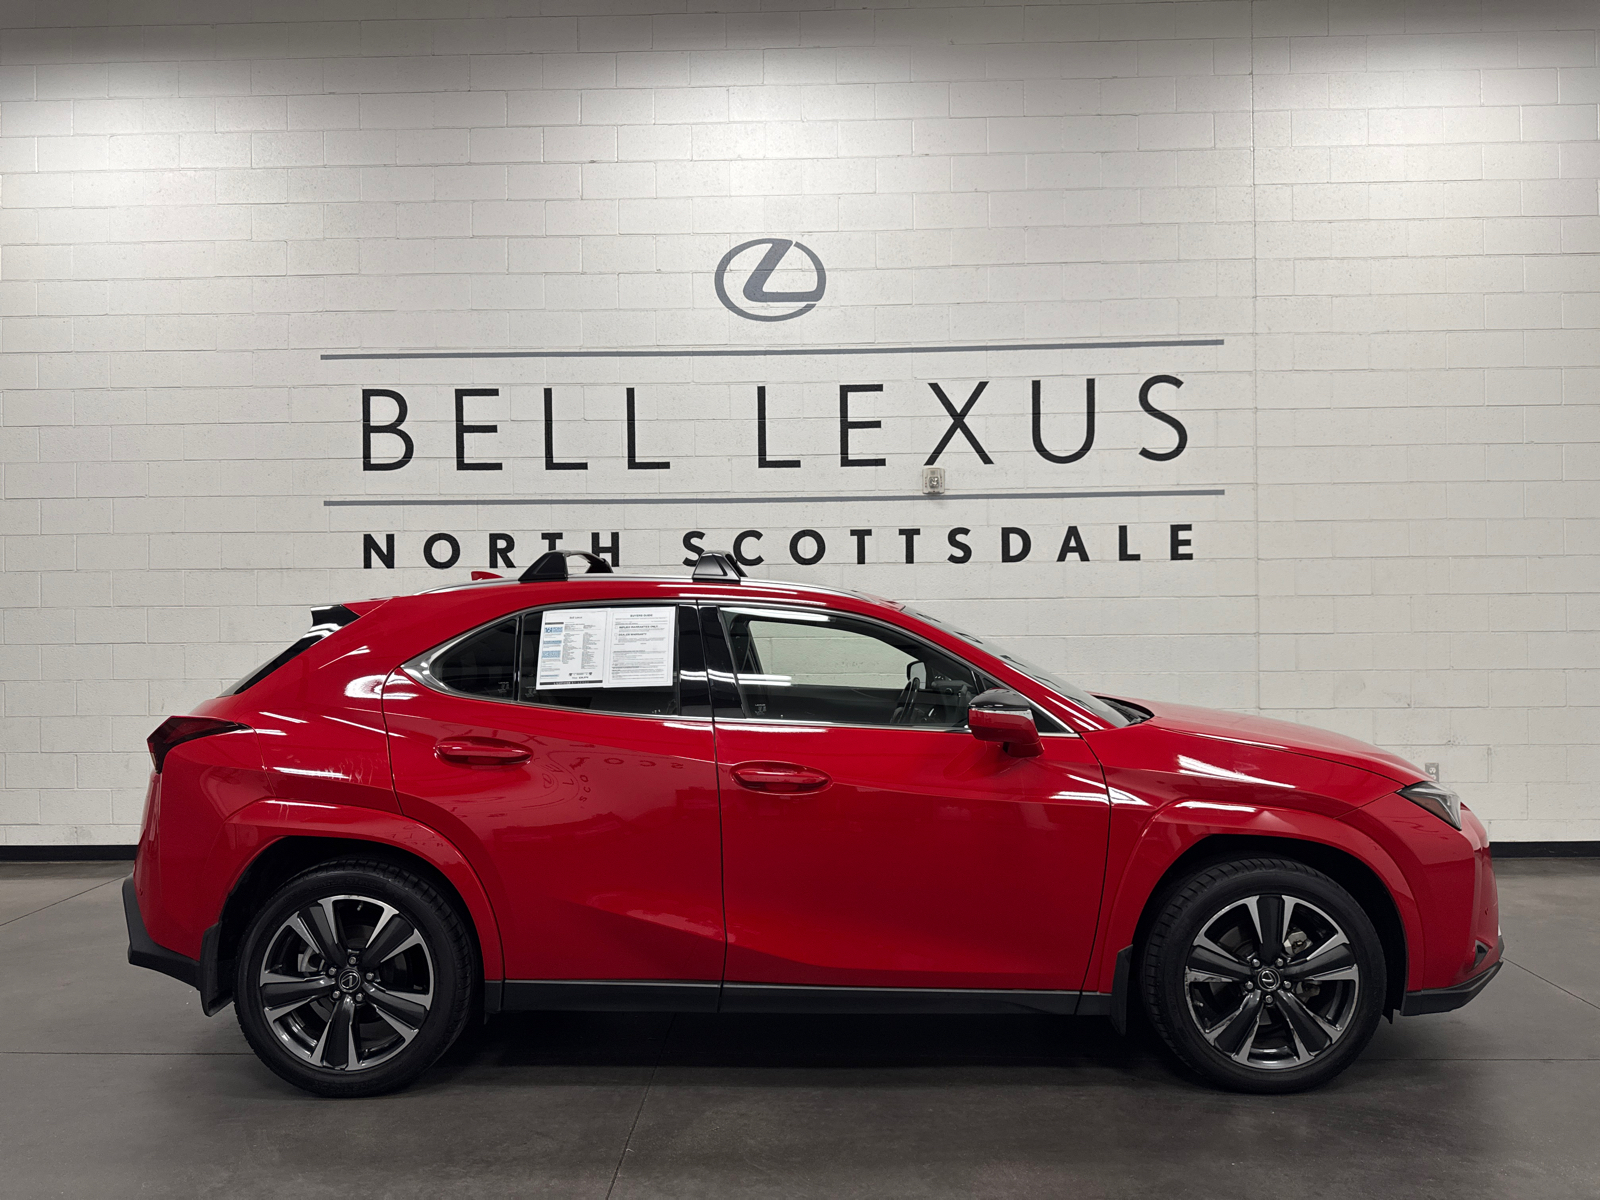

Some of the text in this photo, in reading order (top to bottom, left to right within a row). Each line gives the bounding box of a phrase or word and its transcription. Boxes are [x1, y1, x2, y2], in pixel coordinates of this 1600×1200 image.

[362, 375, 1188, 471] BELL LEXUS
[363, 524, 1194, 569] NORTH SCOTTSDALE
